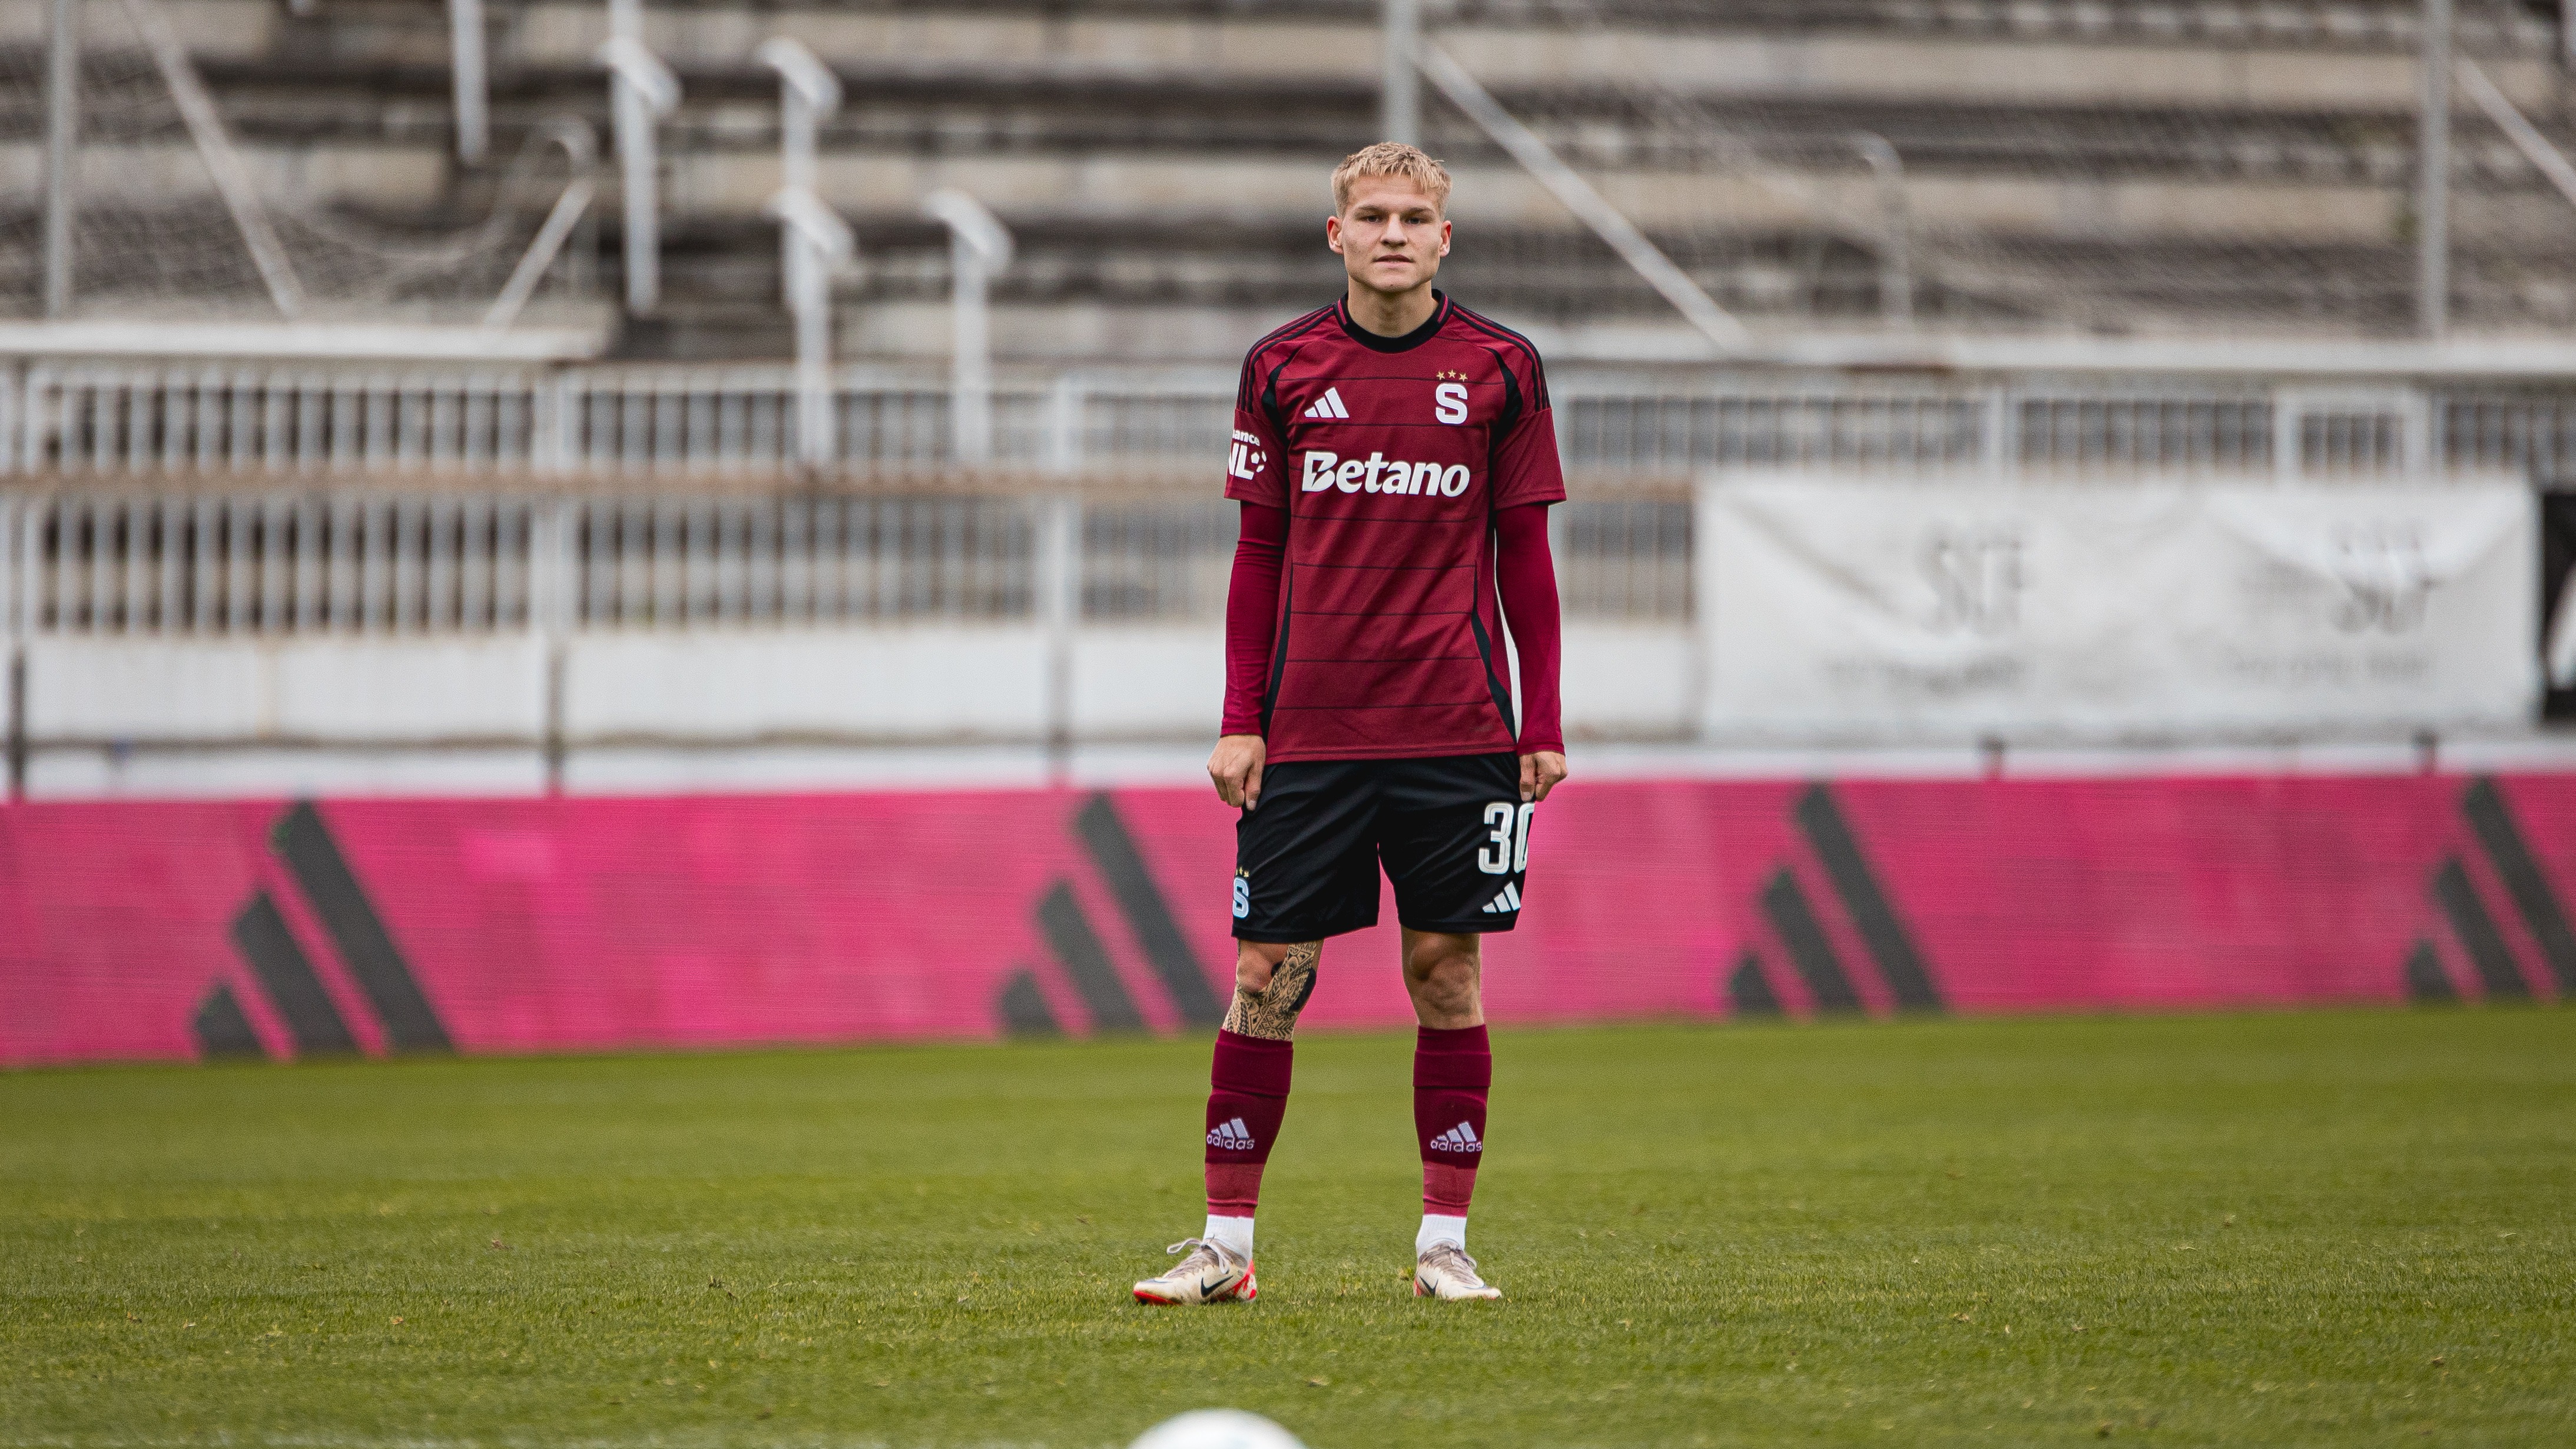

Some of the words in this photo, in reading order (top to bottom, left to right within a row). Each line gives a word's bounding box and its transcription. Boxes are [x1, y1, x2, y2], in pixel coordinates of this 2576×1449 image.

[1435, 383, 1468, 424] S
[1232, 429, 1260, 446] ance
[1302, 450, 1470, 497] Betano
[1232, 877, 1249, 918] S
[1206, 1134, 1255, 1150] adidas
[1430, 1139, 1483, 1152] adidas
